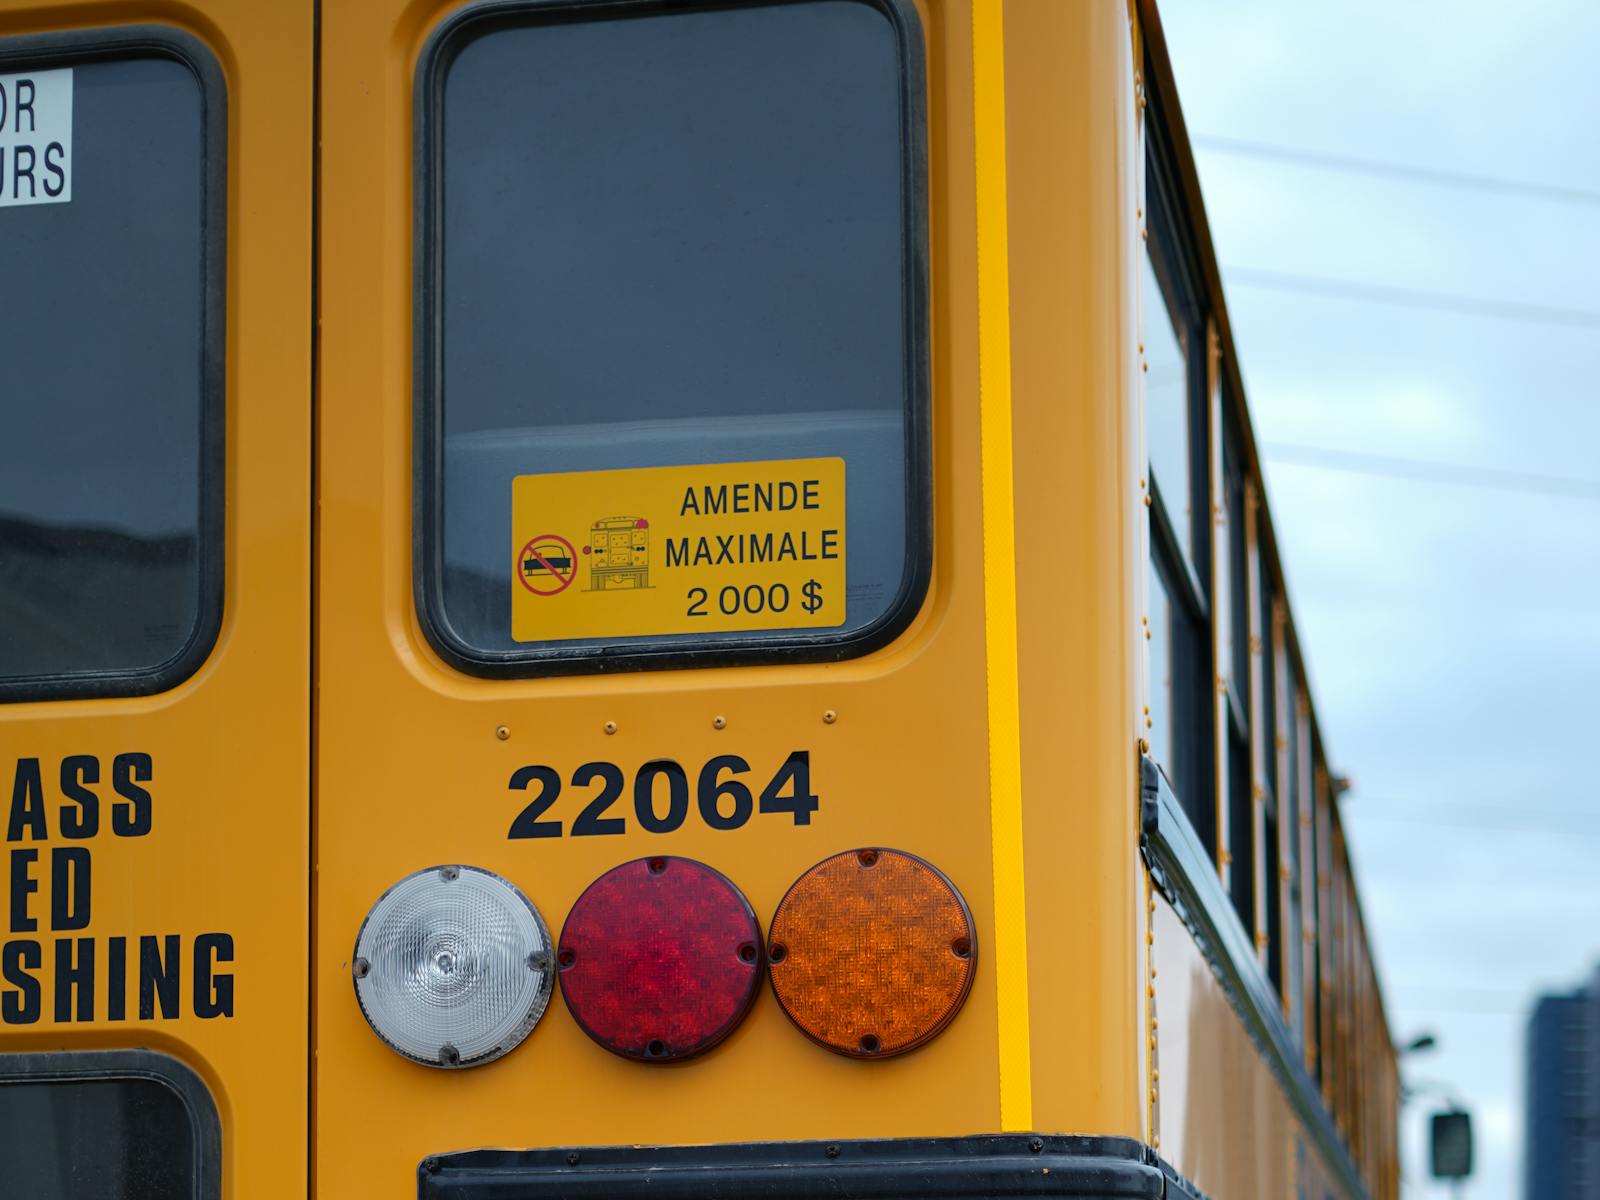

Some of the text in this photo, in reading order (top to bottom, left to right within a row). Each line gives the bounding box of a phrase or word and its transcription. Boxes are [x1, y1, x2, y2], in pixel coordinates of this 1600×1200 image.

[0, 141, 65, 199] RS
[680, 480, 820, 516] AMENDE
[665, 529, 839, 568] MAXIMALE
[801, 578, 824, 615] $
[6, 752, 153, 842] ASS
[507, 750, 820, 840] 22064
[9, 847, 92, 933] ED
[1, 932, 235, 1025] SHING
